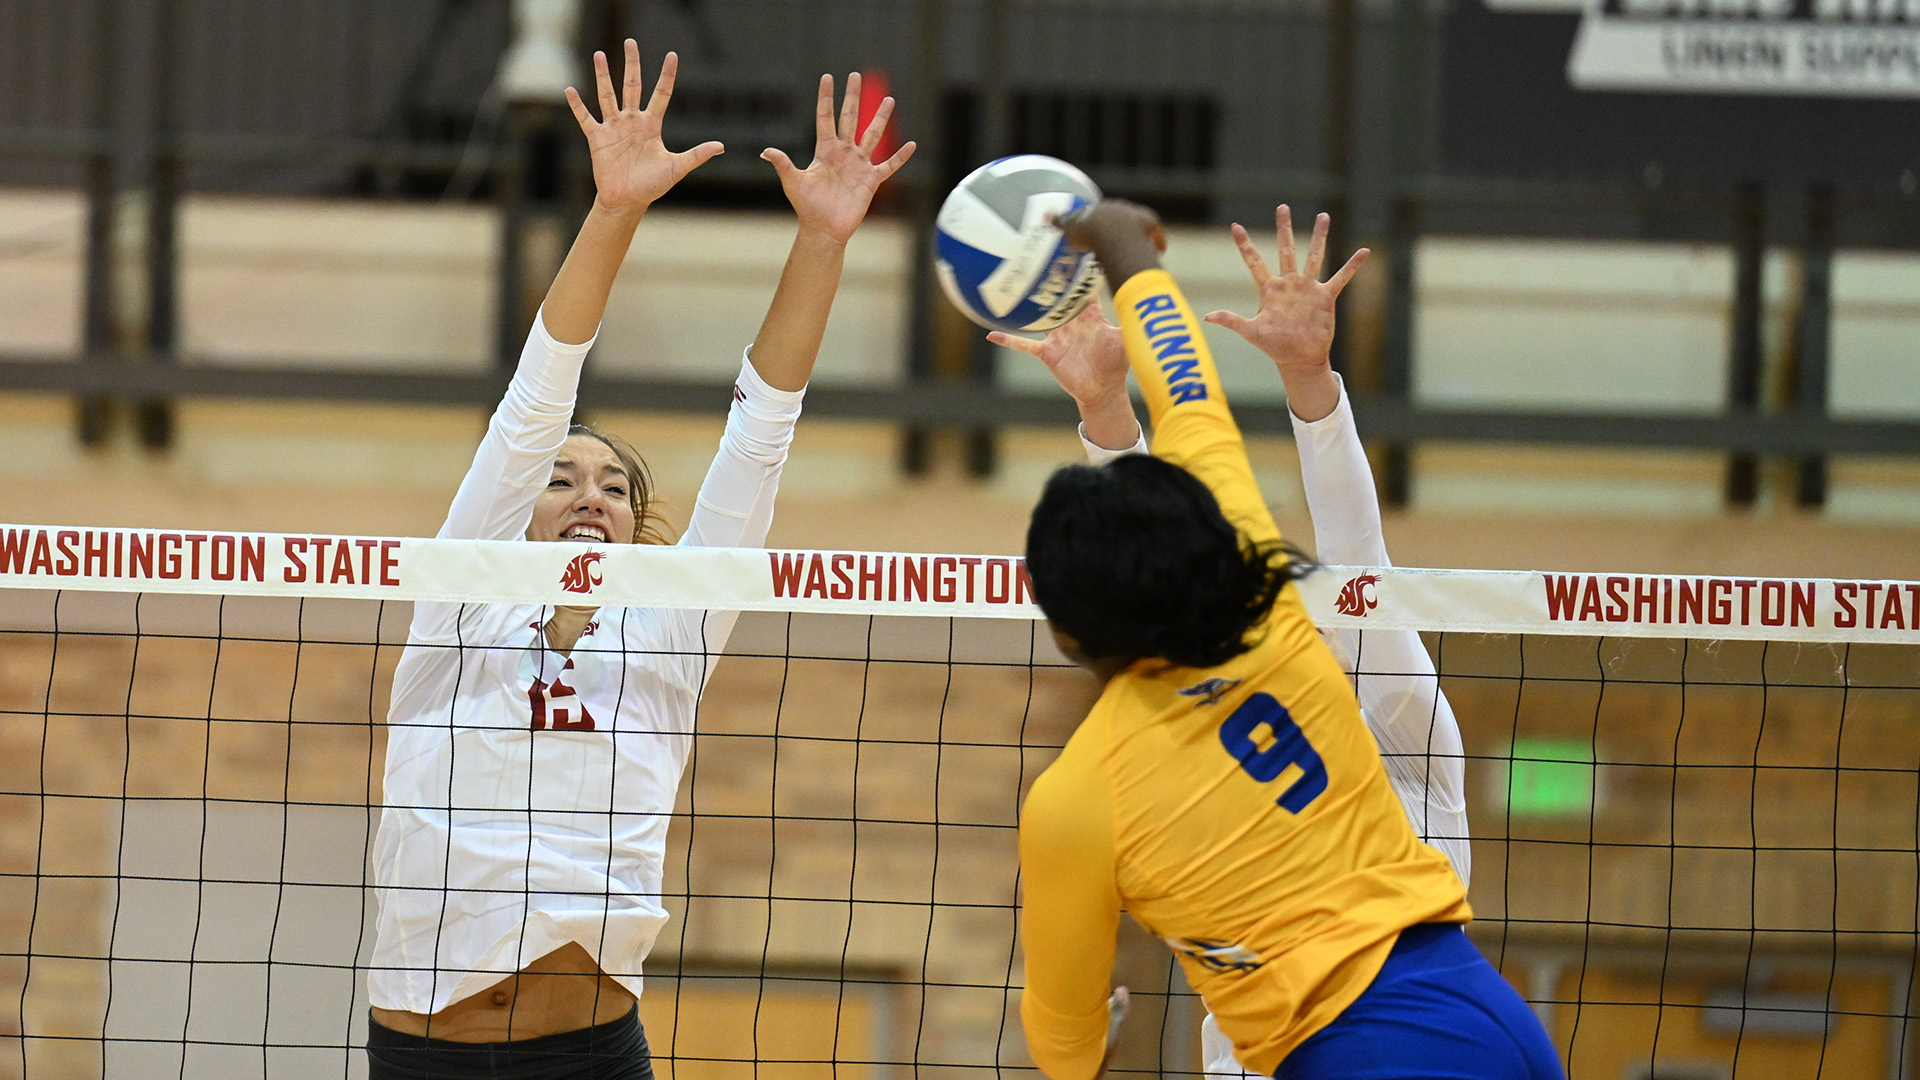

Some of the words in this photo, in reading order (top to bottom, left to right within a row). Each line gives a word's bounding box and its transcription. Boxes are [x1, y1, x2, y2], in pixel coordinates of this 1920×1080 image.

[0, 528, 265, 582] WASHINGTON
[283, 537, 400, 586] STATE
[770, 551, 1038, 605] WASHINGTON
[1543, 574, 1816, 628] WASHINGTON
[1833, 582, 1920, 630] STAT
[1219, 692, 1329, 816] 9
